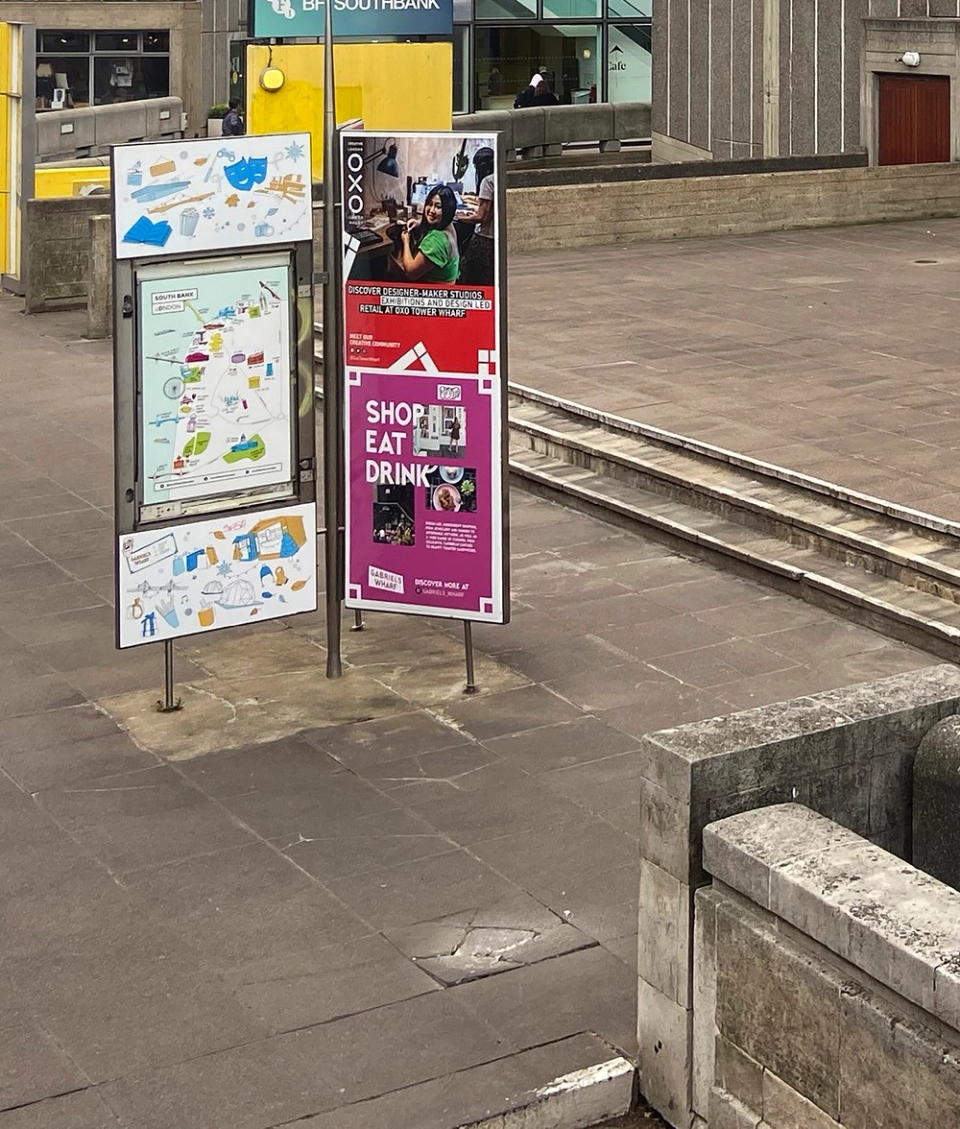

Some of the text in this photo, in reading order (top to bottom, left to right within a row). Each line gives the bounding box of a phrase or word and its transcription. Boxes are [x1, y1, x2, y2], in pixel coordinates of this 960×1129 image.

[347, 153, 364, 214] OXO
[154, 291, 195, 301] SOUTH BANK
[348, 286, 381, 295] DISCOVER
[383, 288, 449, 299] DESIGNER-MAKER
[154, 303, 182, 312] LONDON
[381, 297, 490, 309] EXHIBITIONS AND DESIGN LED
[360, 305, 466, 317] RETAIL AT OXO TOWER WHARF
[366, 399, 425, 429] SHOP
[366, 429, 407, 455] EAT
[366, 459, 438, 488] DRINK
[414, 578, 443, 587] DISCOVER
[444, 582, 460, 590] MORE
